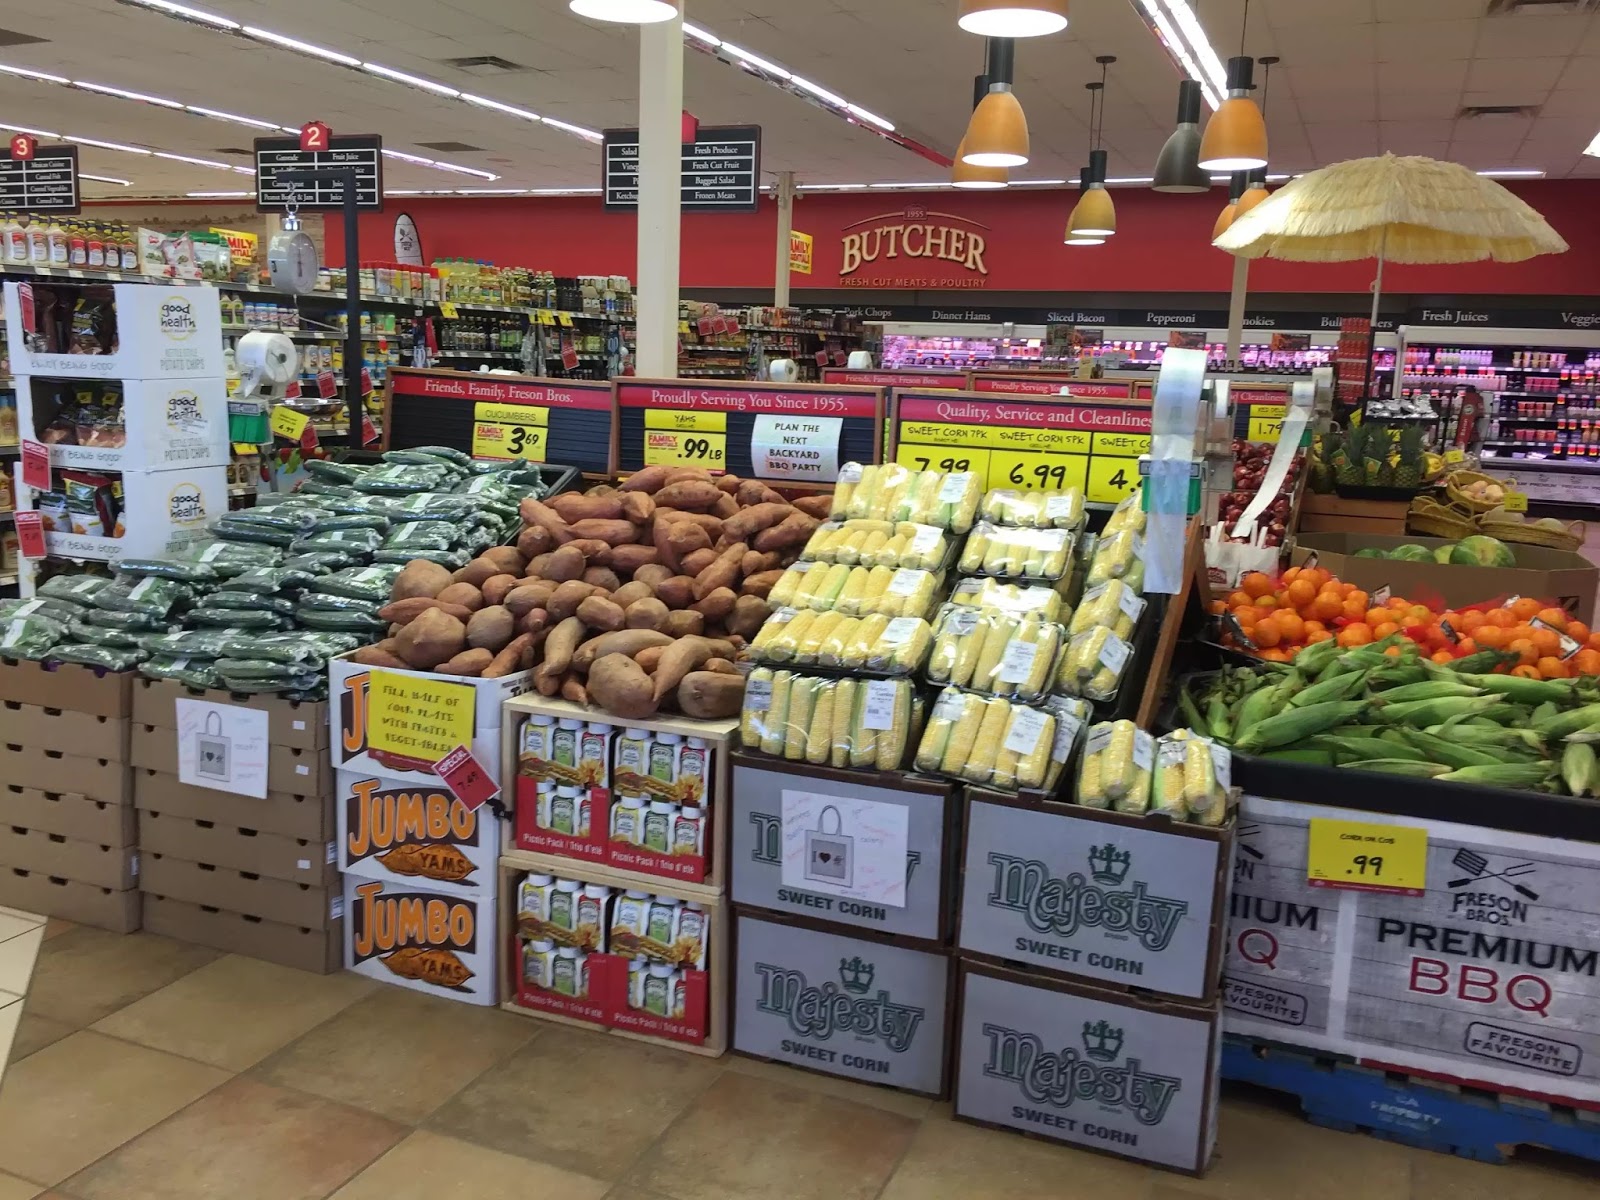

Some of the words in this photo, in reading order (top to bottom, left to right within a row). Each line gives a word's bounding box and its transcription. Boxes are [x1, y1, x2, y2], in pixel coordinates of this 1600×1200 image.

[307, 127, 321, 146] 2
[16, 139, 28, 155] 3
[621, 148, 638, 156] Salad
[694, 147, 711, 155] Fresh
[712, 147, 738, 155] Produce
[346, 153, 359, 161] Juice
[621, 163, 639, 172] Vineg
[692, 162, 709, 170] Fresh
[723, 161, 740, 169] Fruit
[695, 177, 718, 186] Bagged
[718, 176, 736, 184] Salad
[616, 192, 639, 201] Ketchu
[695, 192, 716, 200] Frozen
[907, 210, 924, 218] 1955
[839, 224, 988, 275] BUTCHER
[839, 278, 869, 286] FRESH
[872, 278, 891, 287] CUT
[894, 278, 927, 287] MEATS
[929, 278, 938, 287] &
[940, 278, 986, 287] POULTRY
[162, 304, 190, 317] good
[865, 307, 892, 320] Chops
[932, 310, 963, 320] Dinner
[965, 311, 991, 321] Hams
[1047, 312, 1074, 322] Sliced
[1077, 313, 1105, 323] Bacon
[1422, 310, 1452, 321] Fresh
[1454, 310, 1489, 324] Juices
[161, 314, 196, 328] health
[1147, 312, 1196, 325] Pepperoni
[1242, 316, 1275, 326] mokies
[425, 380, 465, 395] Friends,
[468, 383, 505, 399] Family,
[508, 386, 543, 400] Freson
[546, 389, 574, 403] Bros.
[991, 382, 1020, 393] Proudly
[1020, 383, 1048, 394] Serving
[1070, 386, 1086, 394] ince
[1088, 386, 1108, 395] 1955.
[168, 396, 198, 411] good
[652, 390, 698, 407] Proudly
[700, 392, 746, 411] Serving
[749, 394, 772, 408] You
[775, 395, 808, 410] Since
[813, 397, 848, 411] 1955.
[485, 409, 537, 421] CUCUMBERS
[937, 402, 991, 422] Quality,
[995, 405, 1044, 421] Service
[1048, 408, 1074, 423] and
[1079, 409, 1152, 427] Cleanlines
[774, 422, 799, 431] PLAN
[803, 424, 820, 432] THE
[908, 427, 941, 436] SWEET
[943, 428, 968, 437] CORN
[971, 430, 987, 439] 7PK
[649, 434, 678, 444] FAMILY
[783, 436, 808, 445] NEXT
[1000, 432, 1034, 441] SWEET
[1037, 433, 1063, 443] CORN
[1066, 435, 1084, 444] 5PK
[1100, 438, 1137, 447] SWEET
[709, 450, 722, 460] LB
[769, 449, 820, 459] BACKYARD
[769, 461, 788, 470] BBQ
[792, 463, 822, 471] PARTY
[1010, 463, 1066, 489] 6.99
[171, 492, 201, 508] good
[170, 504, 206, 519] health
[383, 685, 407, 698] FILL
[412, 691, 441, 703] HALF
[445, 698, 459, 706] OF
[418, 709, 454, 721] PLATE
[382, 717, 408, 728] WITH
[412, 722, 447, 736] FRUITS
[348, 778, 476, 857] JUMBO
[523, 833, 545, 845] Picnic
[545, 837, 564, 848] Pack
[420, 852, 466, 875] YAMS
[611, 851, 634, 863] Picnic
[635, 855, 655, 866] Pack
[1346, 855, 1383, 876] .99
[777, 889, 835, 910] SWEET
[838, 901, 886, 921] CORN
[1452, 892, 1527, 922] FRESON
[354, 881, 475, 957] JUMBO
[1466, 909, 1512, 927] BROS.
[1377, 917, 1599, 977] PREMIUM
[1015, 937, 1082, 962] SWEET
[1087, 952, 1144, 975] CORN
[420, 957, 463, 979] YAMS
[1224, 982, 1288, 1005] FRESON
[1408, 956, 1552, 1018] BBQ
[1229, 994, 1300, 1020] VOURITE
[1488, 1031, 1561, 1056] FRESON
[781, 1039, 838, 1063] SWEET
[842, 1054, 890, 1073] CORN
[1471, 1039, 1573, 1071] FAVOURITE
[1012, 1105, 1079, 1132] SWEET
[1082, 1123, 1139, 1146] CORN
